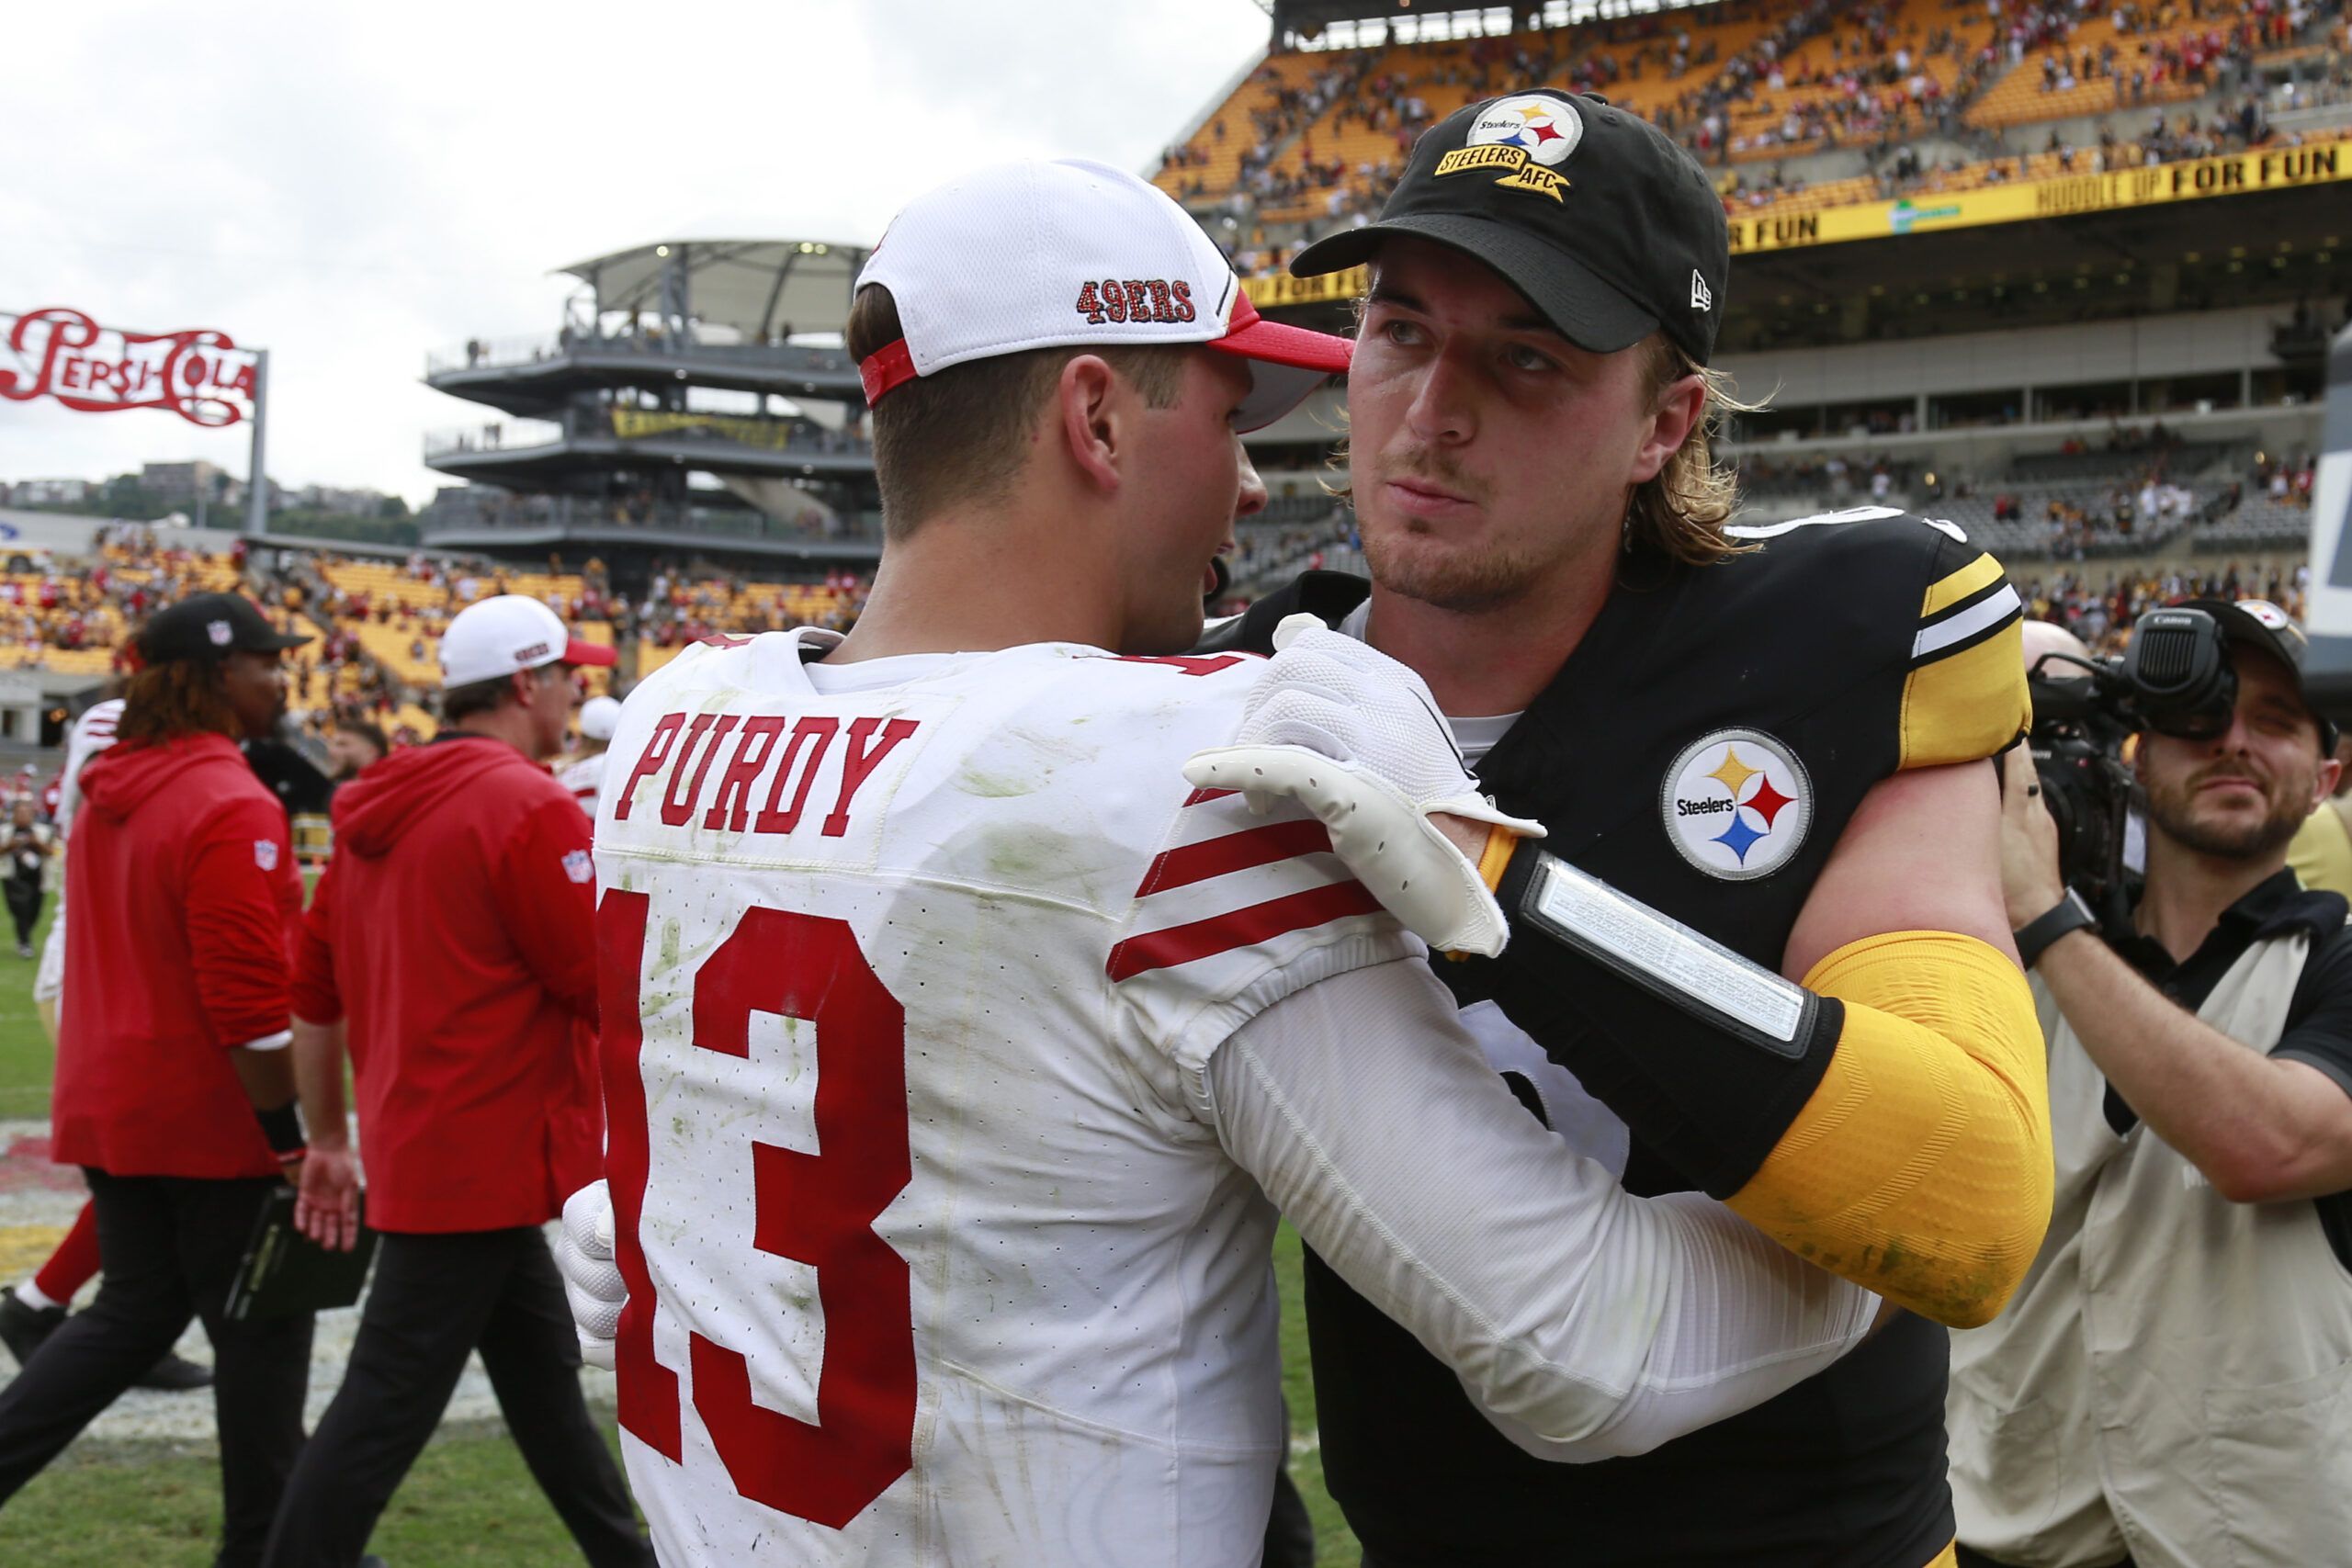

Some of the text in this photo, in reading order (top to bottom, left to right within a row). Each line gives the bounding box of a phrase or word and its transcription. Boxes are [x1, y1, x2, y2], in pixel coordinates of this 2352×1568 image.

[1479, 120, 1521, 130] Steelers
[1440, 147, 1521, 172] STEELERS
[2172, 161, 2245, 194] FOR
[2260, 148, 2337, 183] FUN
[1519, 167, 1557, 189] AFC
[1756, 212, 1819, 244] FUN
[1077, 279, 1195, 324] 49ERS
[2154, 615, 2192, 626] Canon
[615, 712, 922, 838] PURDY
[1677, 796, 1735, 818] Steelers
[596, 886, 919, 1531] 13
